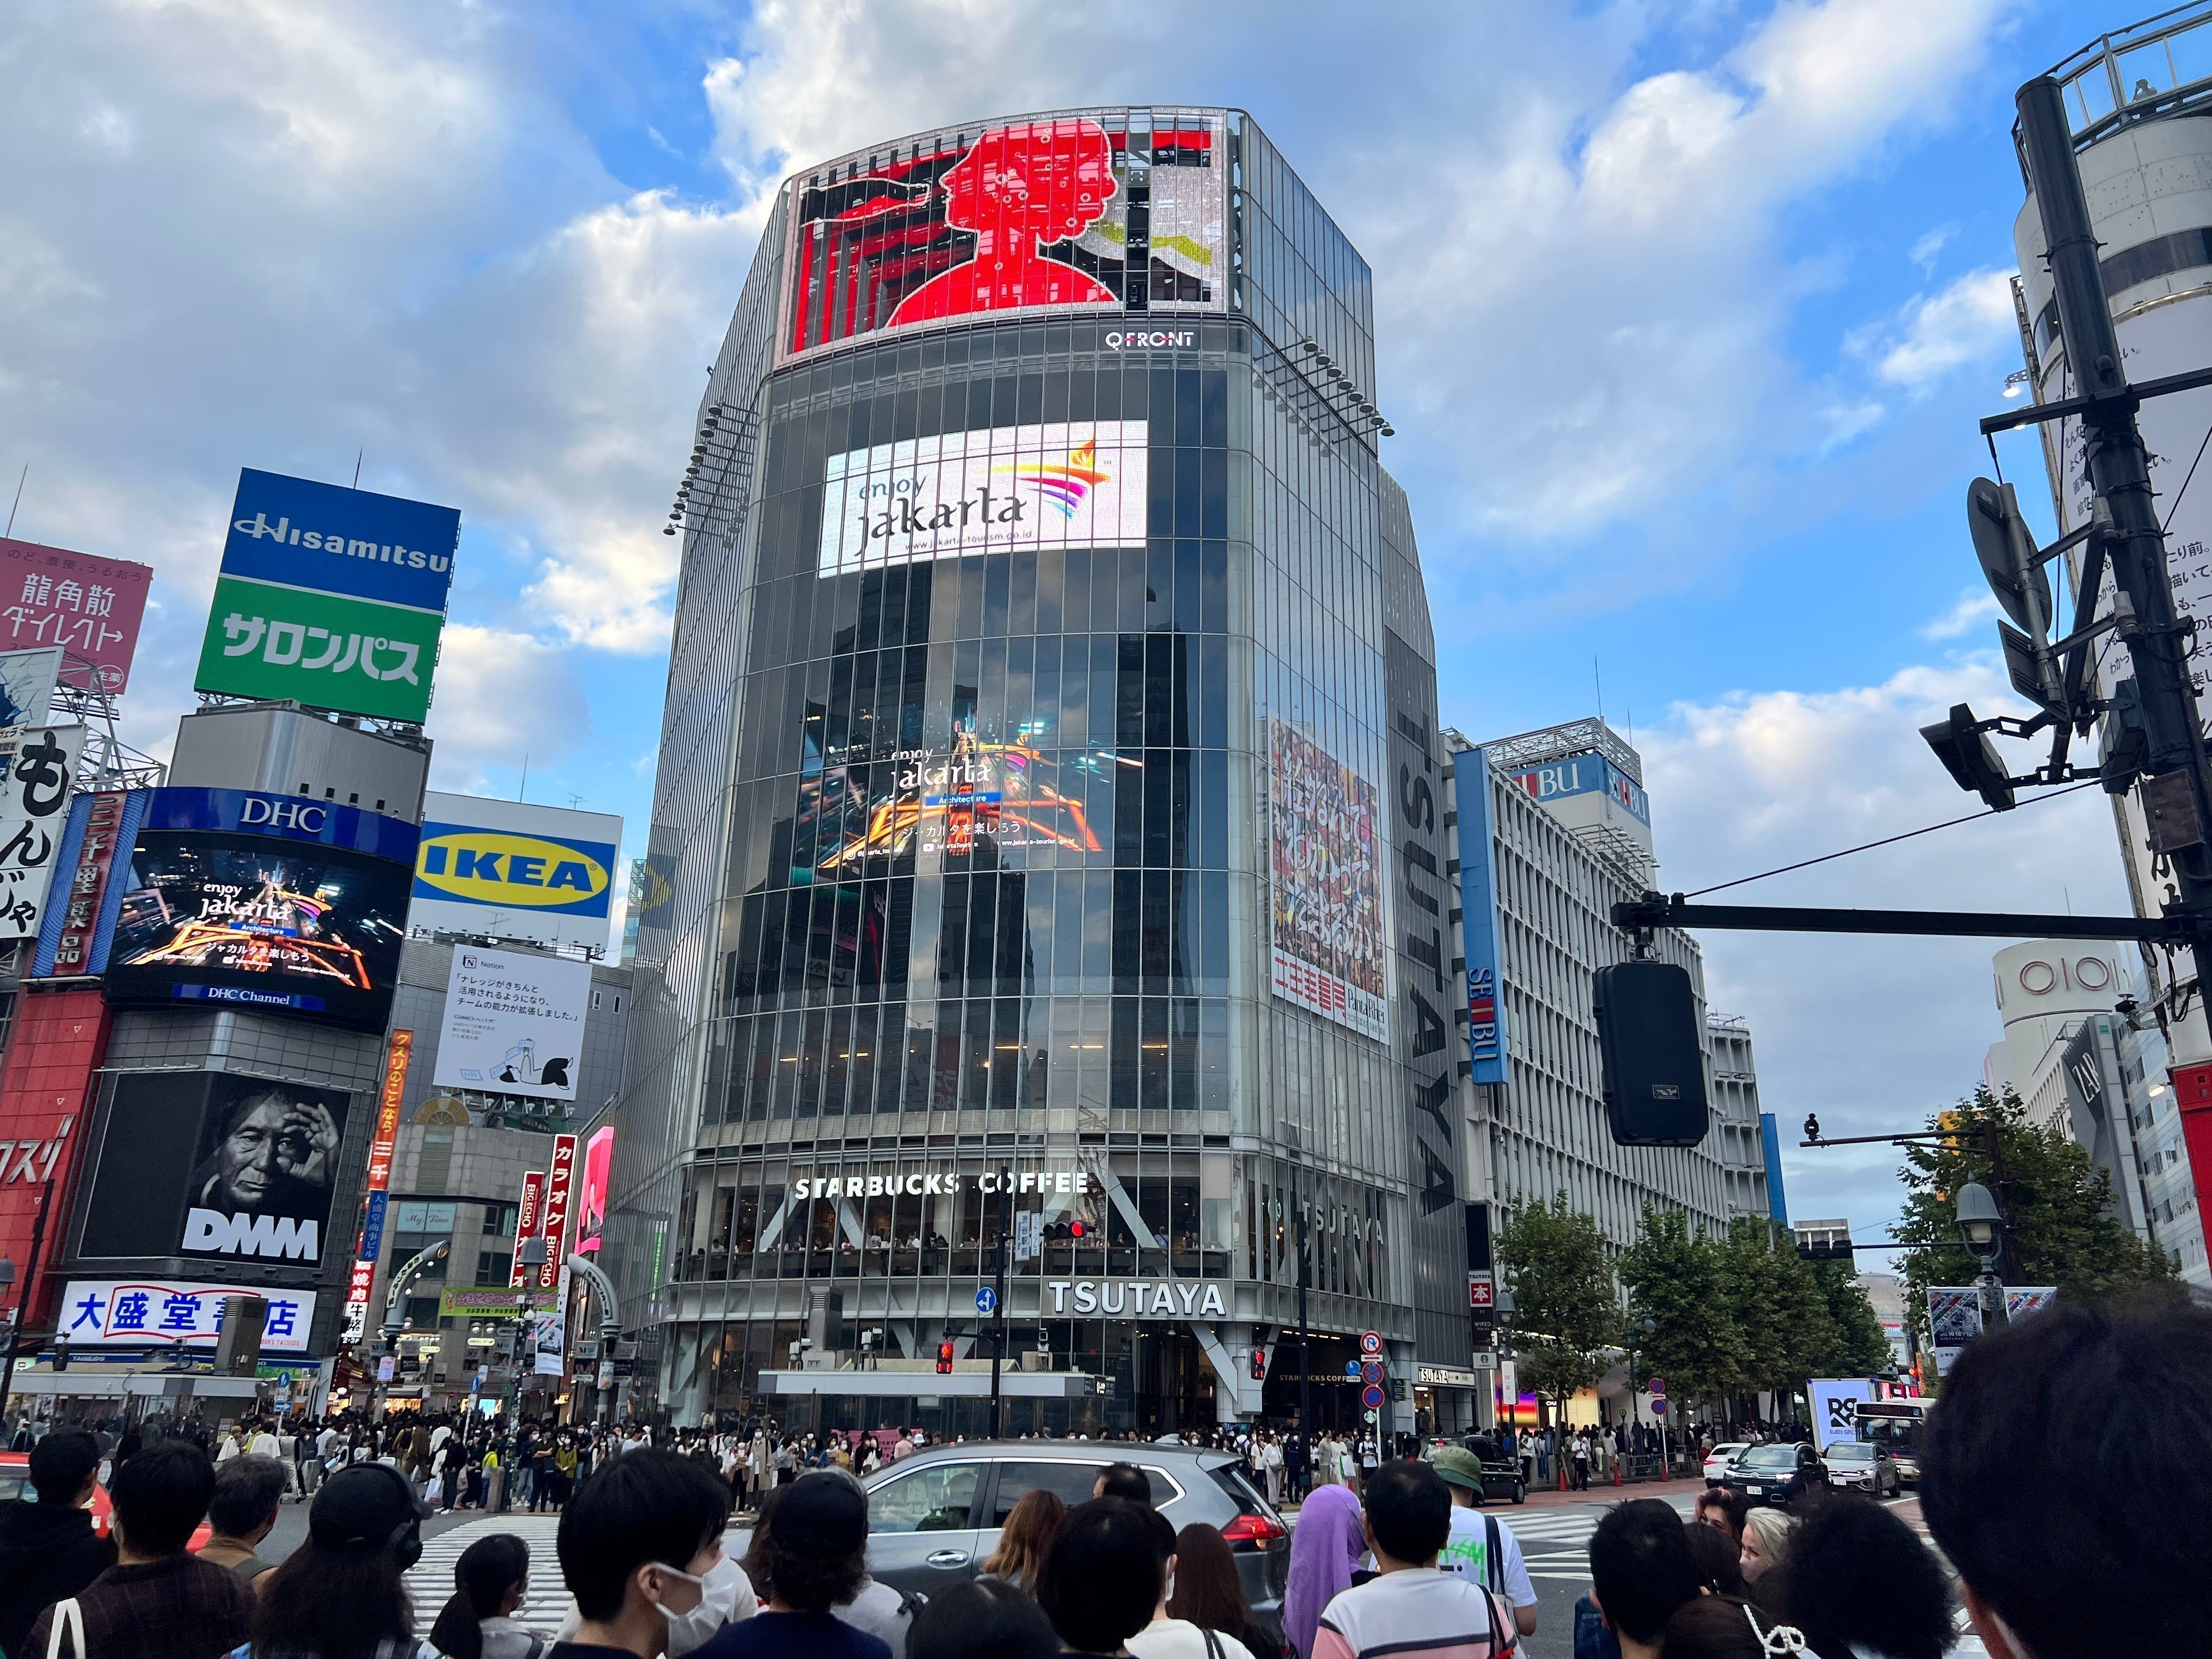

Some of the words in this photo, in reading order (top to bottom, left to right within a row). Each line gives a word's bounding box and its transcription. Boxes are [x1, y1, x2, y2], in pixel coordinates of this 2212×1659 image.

[1105, 331, 1194, 352] QFRONT
[859, 476, 927, 501] enjoy
[854, 487, 1027, 557] jakarta
[234, 512, 449, 572] Hisamitsu
[8, 549, 142, 582] のど、直接、うるおう
[2170, 563, 2212, 588] 描いて
[21, 573, 116, 618] 龍角散
[2, 606, 123, 652] ダイレクト
[223, 612, 421, 686] サロンパス
[891, 748, 934, 765] enjoy
[890, 758, 993, 799] jakarta
[1607, 766, 1647, 822] SEIBU
[240, 797, 326, 832] DHC
[902, 820, 1020, 840] ジカルタを楽しもう
[54, 797, 118, 964] 三千里薬品
[424, 845, 594, 893] IKEA
[203, 883, 242, 897] enjoy
[198, 894, 292, 921] jakarta
[241, 924, 284, 935] Architecture
[205, 942, 309, 962] ジャカルタを楽しもう
[481, 961, 504, 970] Notion
[1397, 710, 1456, 1220] TSUTAYA
[208, 988, 238, 1000] DHC
[240, 990, 290, 1005] Channel
[456, 973, 539, 994] 「ナレッジがきちんと
[458, 986, 549, 1006] 活用されるようになり、
[457, 997, 578, 1022] チームの能力が拡張しました。」
[1347, 988, 1368, 1017] Panta
[1368, 998, 1385, 1024] Rhei
[1469, 966, 1498, 1064] SEIBU
[382, 1034, 409, 1133] クスリのことなら
[548, 1146, 572, 1226] カラオケ
[795, 1172, 960, 1200] STARBUCKS
[978, 1171, 1088, 1194] COFFEE
[182, 1207, 318, 1260] DMM
[405, 1214, 424, 1226] My
[428, 1214, 449, 1223] Time
[1301, 1201, 1384, 1245] TSUTAYA
[1048, 1281, 1226, 1315] TSUTAYA
[1474, 1285, 1488, 1302] 本
[1419, 1368, 1448, 1382] TSUTAYA
